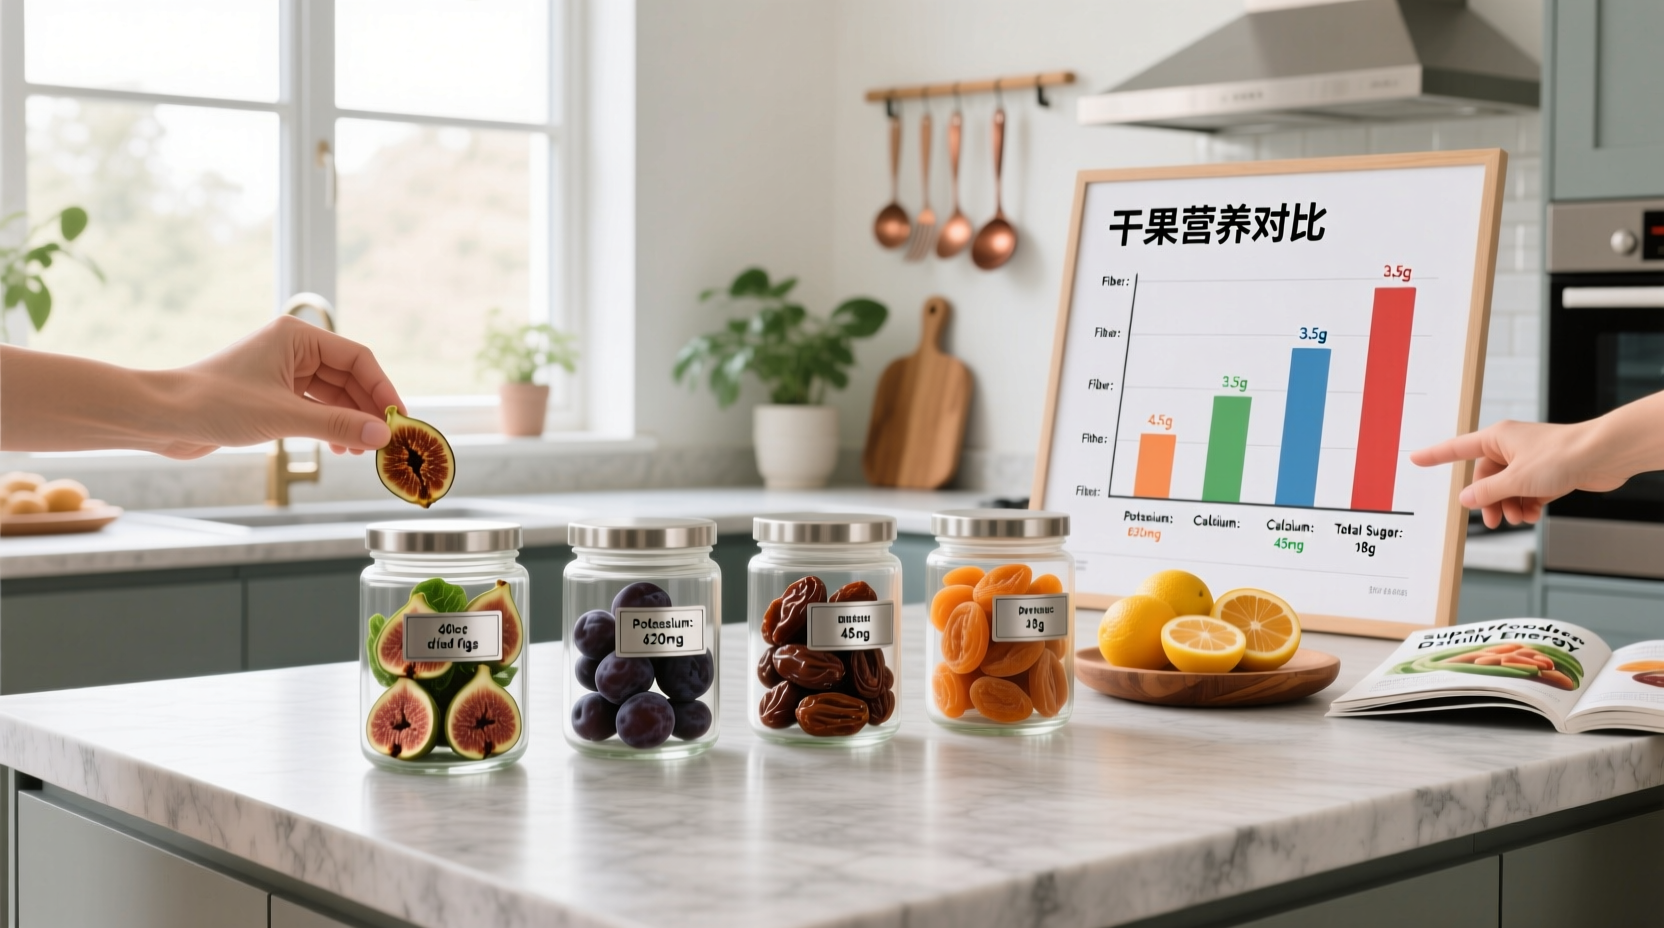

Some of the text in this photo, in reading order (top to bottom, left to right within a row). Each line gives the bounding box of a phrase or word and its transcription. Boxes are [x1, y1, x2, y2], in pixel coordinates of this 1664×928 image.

[1109, 202, 1327, 246] 干果营养对比
[1102, 275, 1130, 286] Fiber:
[1383, 264, 1412, 282] 3.5g
[1299, 327, 1328, 344] 3.5g
[1148, 414, 1173, 431] 4.5g
